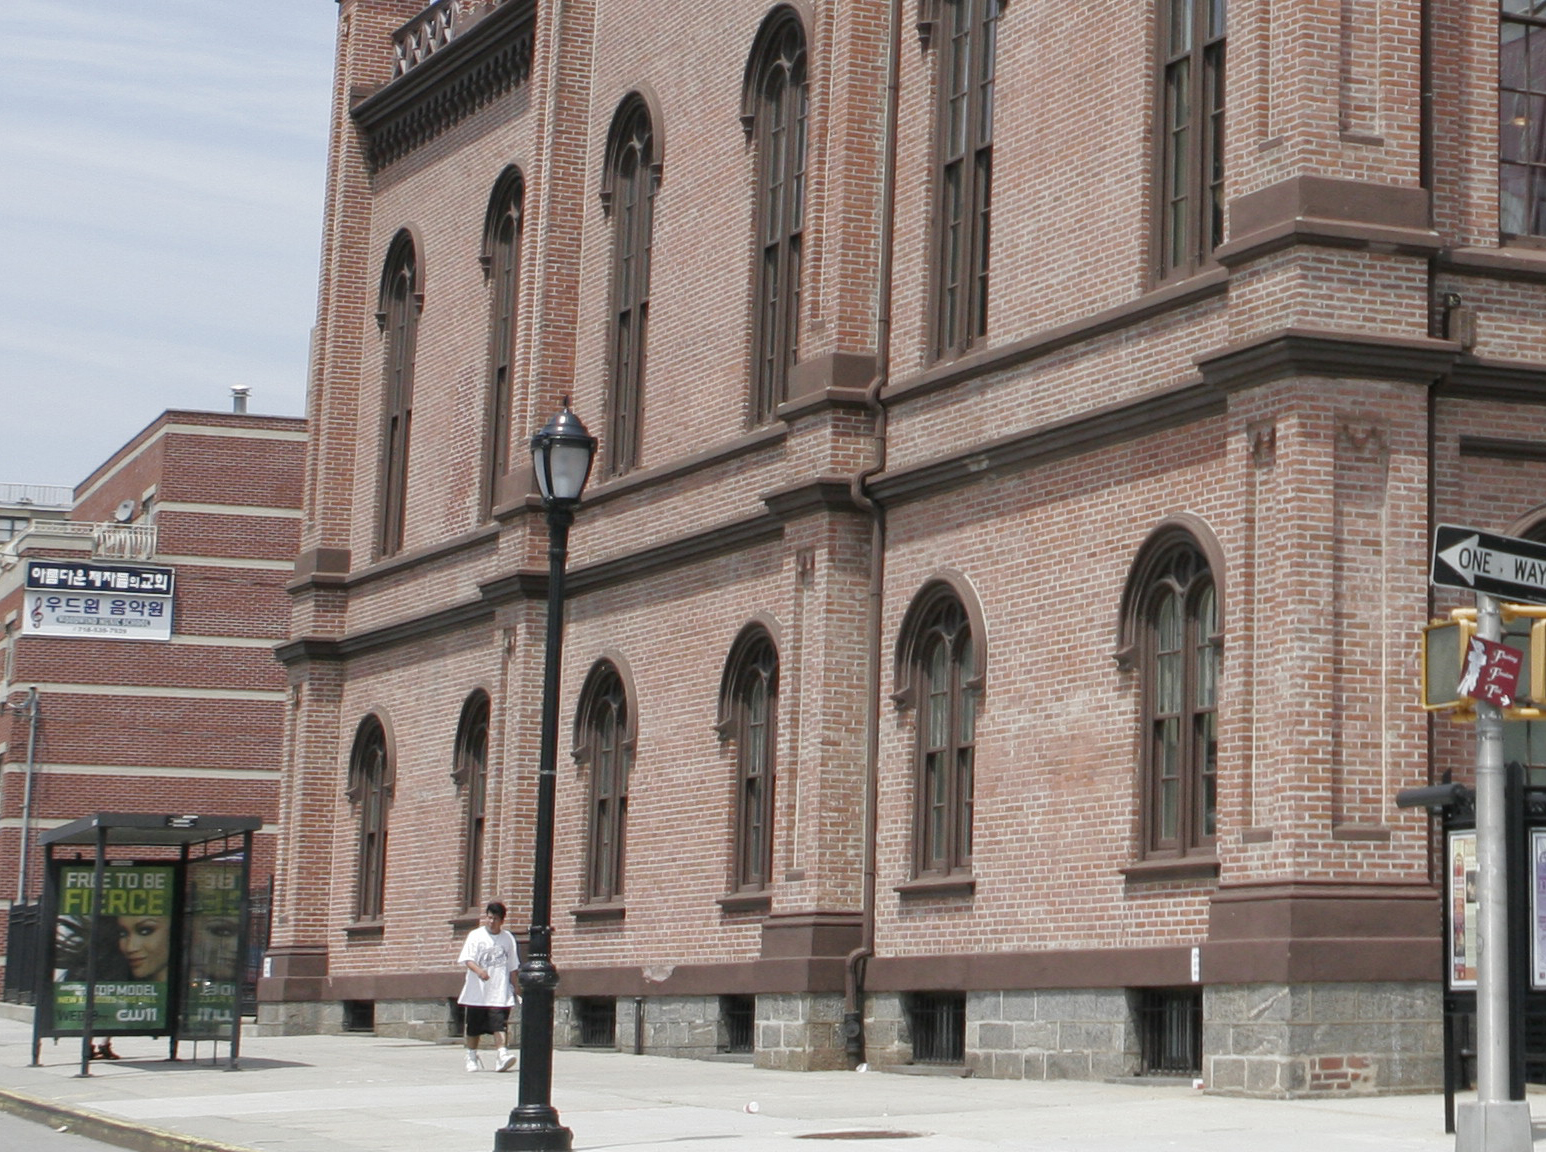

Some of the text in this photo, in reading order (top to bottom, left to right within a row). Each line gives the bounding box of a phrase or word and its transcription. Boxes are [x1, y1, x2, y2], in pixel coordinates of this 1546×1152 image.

[1459, 547, 1492, 574] ONE
[66, 872, 166, 889] FREE TO BE
[64, 889, 164, 915] FIERCE
[116, 984, 158, 996] MODEL
